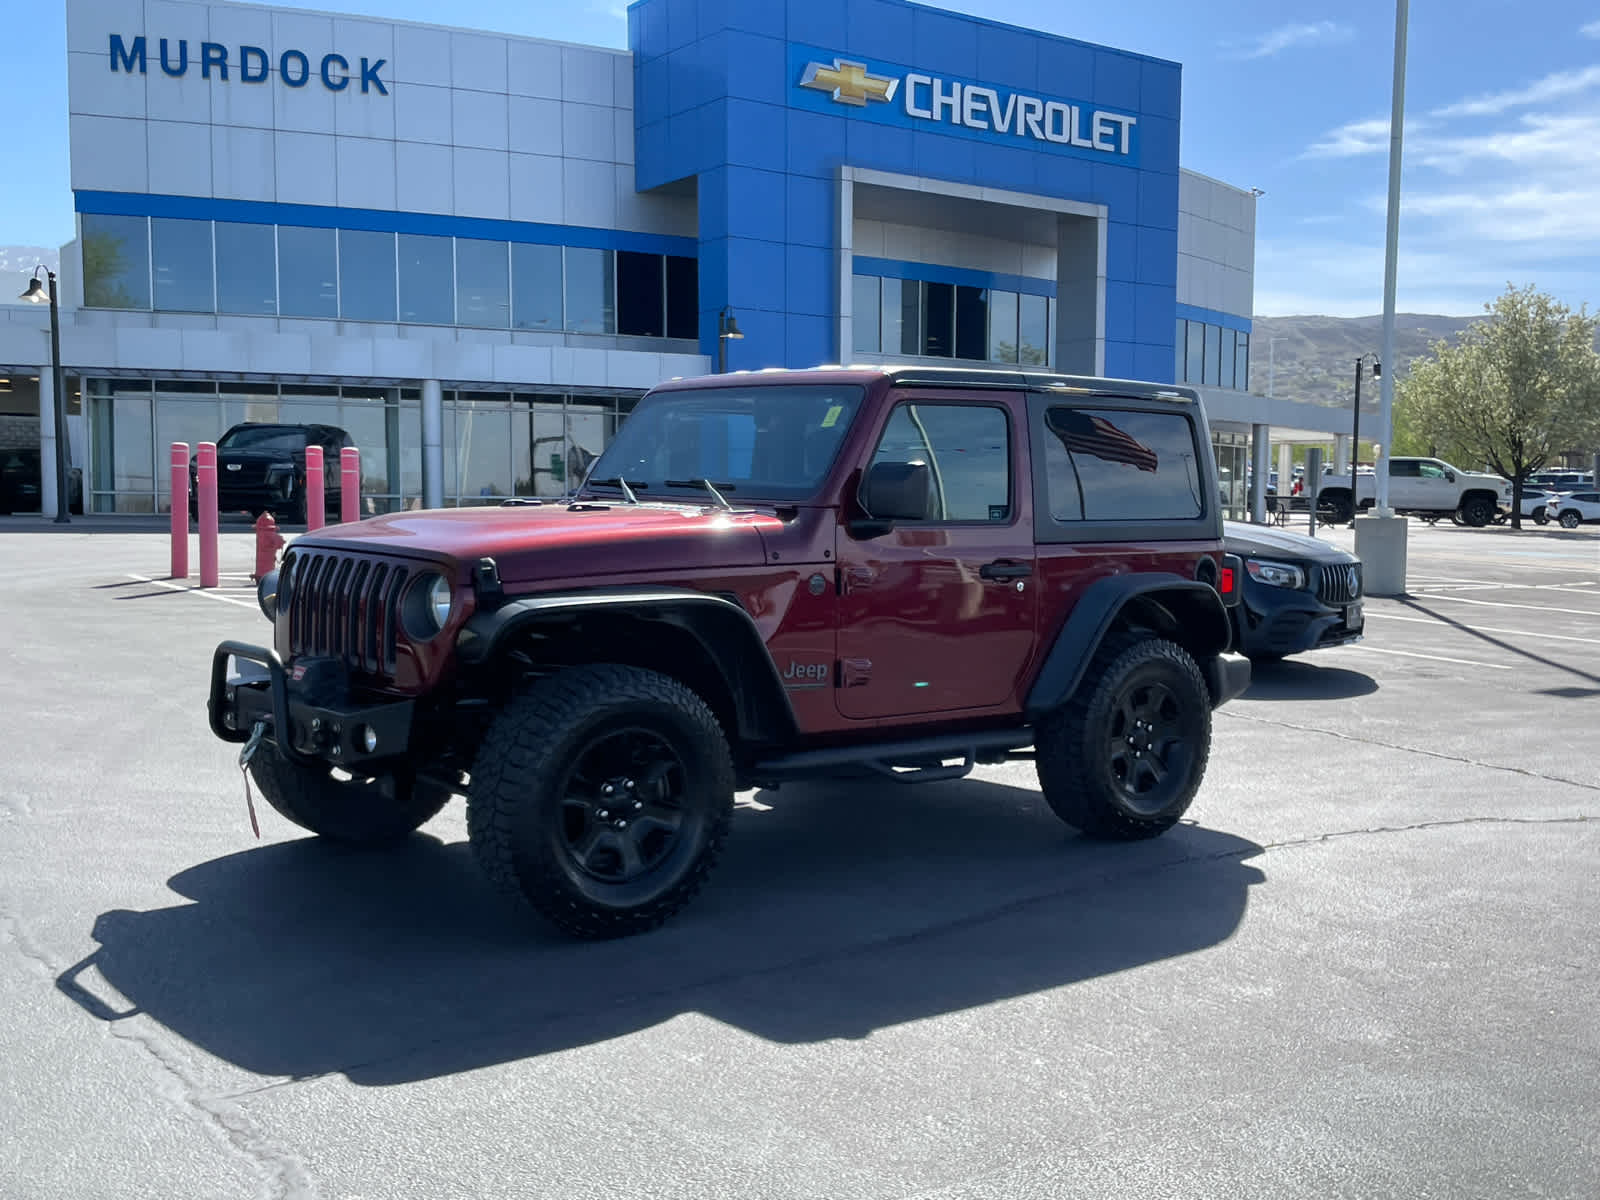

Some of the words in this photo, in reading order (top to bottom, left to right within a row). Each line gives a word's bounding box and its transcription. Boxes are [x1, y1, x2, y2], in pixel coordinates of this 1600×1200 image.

[109, 34, 388, 95] MURDOCK
[905, 73, 1137, 154] CHEVROLET
[783, 660, 828, 681] Jeep
